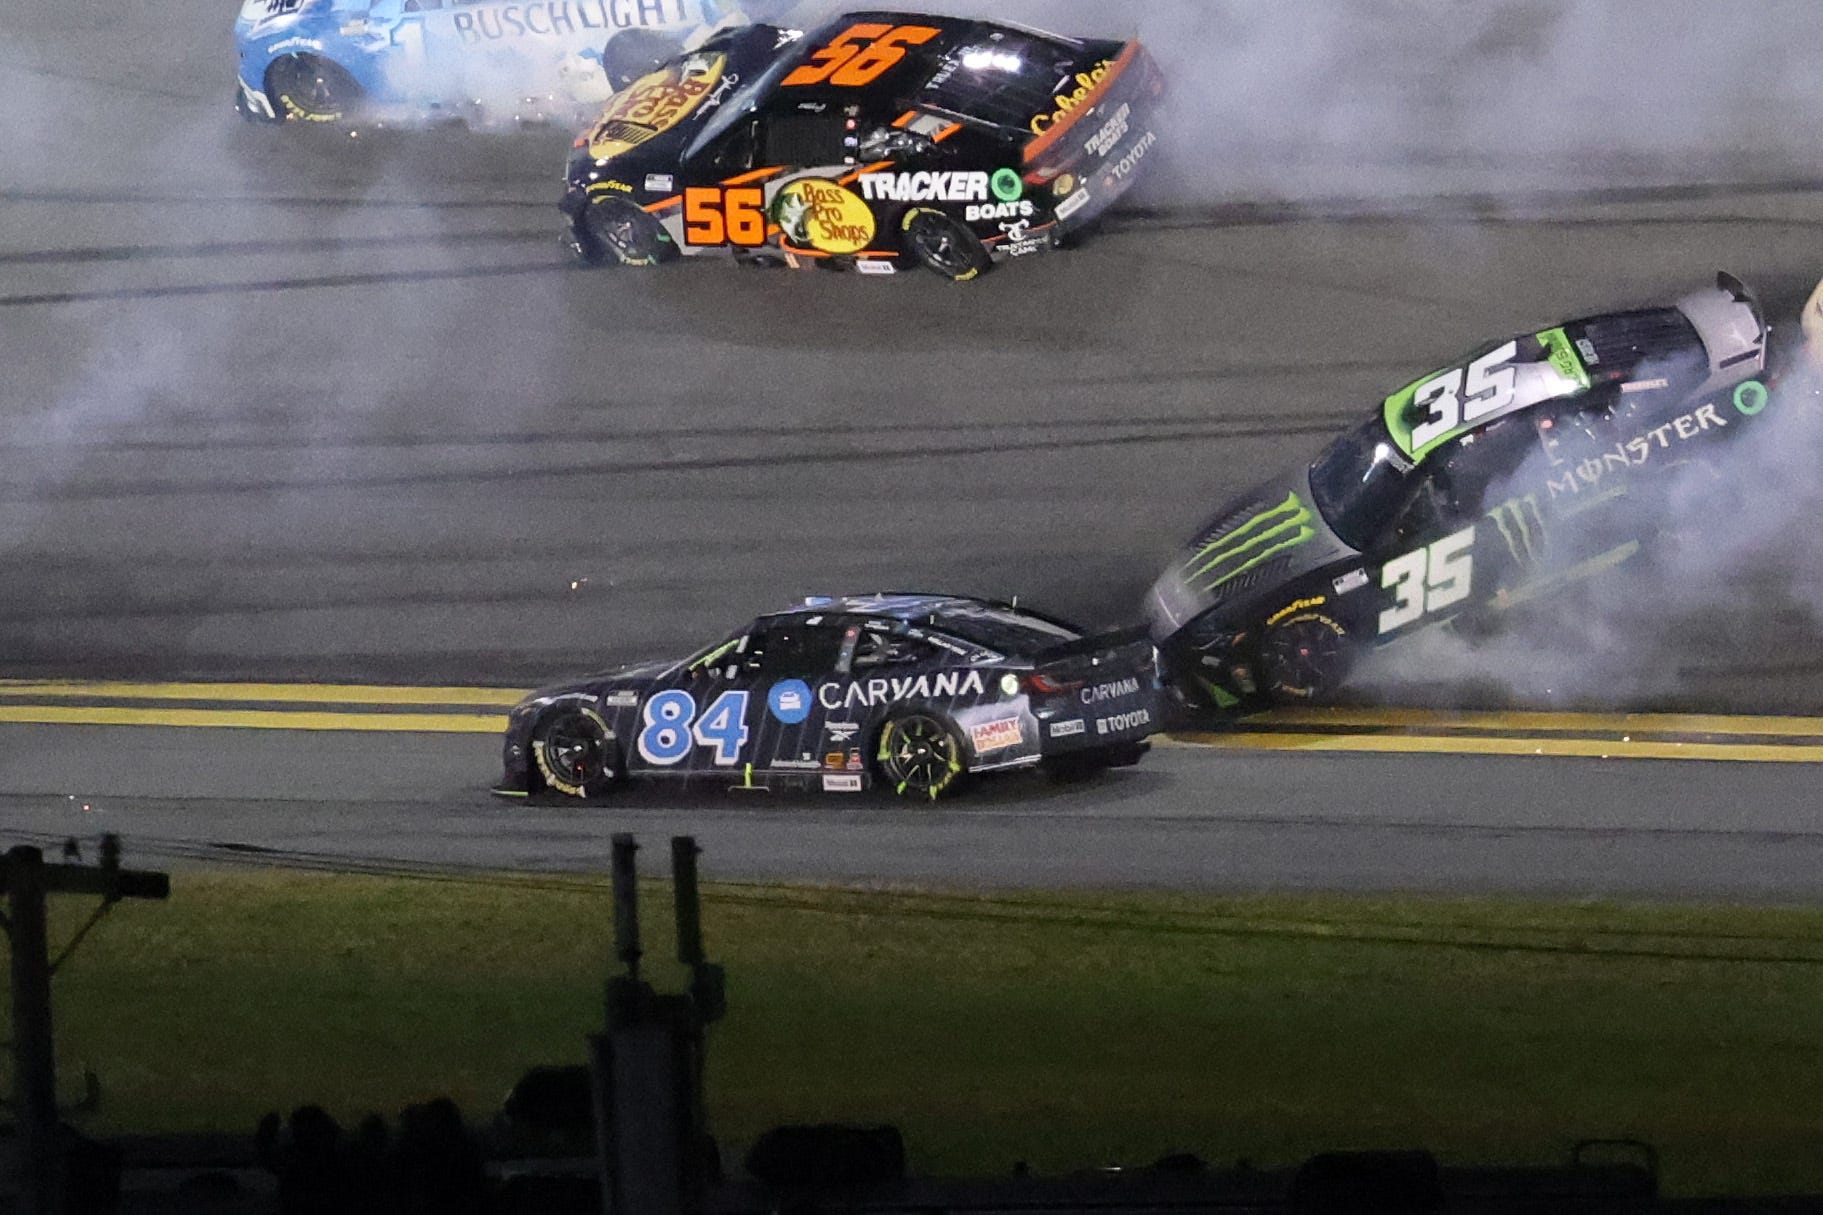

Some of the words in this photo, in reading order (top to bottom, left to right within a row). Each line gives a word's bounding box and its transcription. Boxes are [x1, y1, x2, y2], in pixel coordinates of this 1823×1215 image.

[779, 23, 943, 87] 56
[1111, 131, 1157, 179] TOYOTA
[802, 182, 845, 205] Bass
[858, 170, 989, 202] TRACKER
[685, 186, 765, 246] 56
[812, 202, 843, 223] Pro
[965, 200, 1034, 222] BOATS
[820, 220, 870, 246] Shops
[1410, 340, 1518, 454] 35
[1546, 403, 1729, 499] MONSTER
[1378, 525, 1476, 635] 35
[819, 670, 985, 710] CARVANA
[1080, 677, 1140, 705] CARVANA
[638, 689, 749, 766] 84
[1108, 708, 1152, 732] TOYOTA
